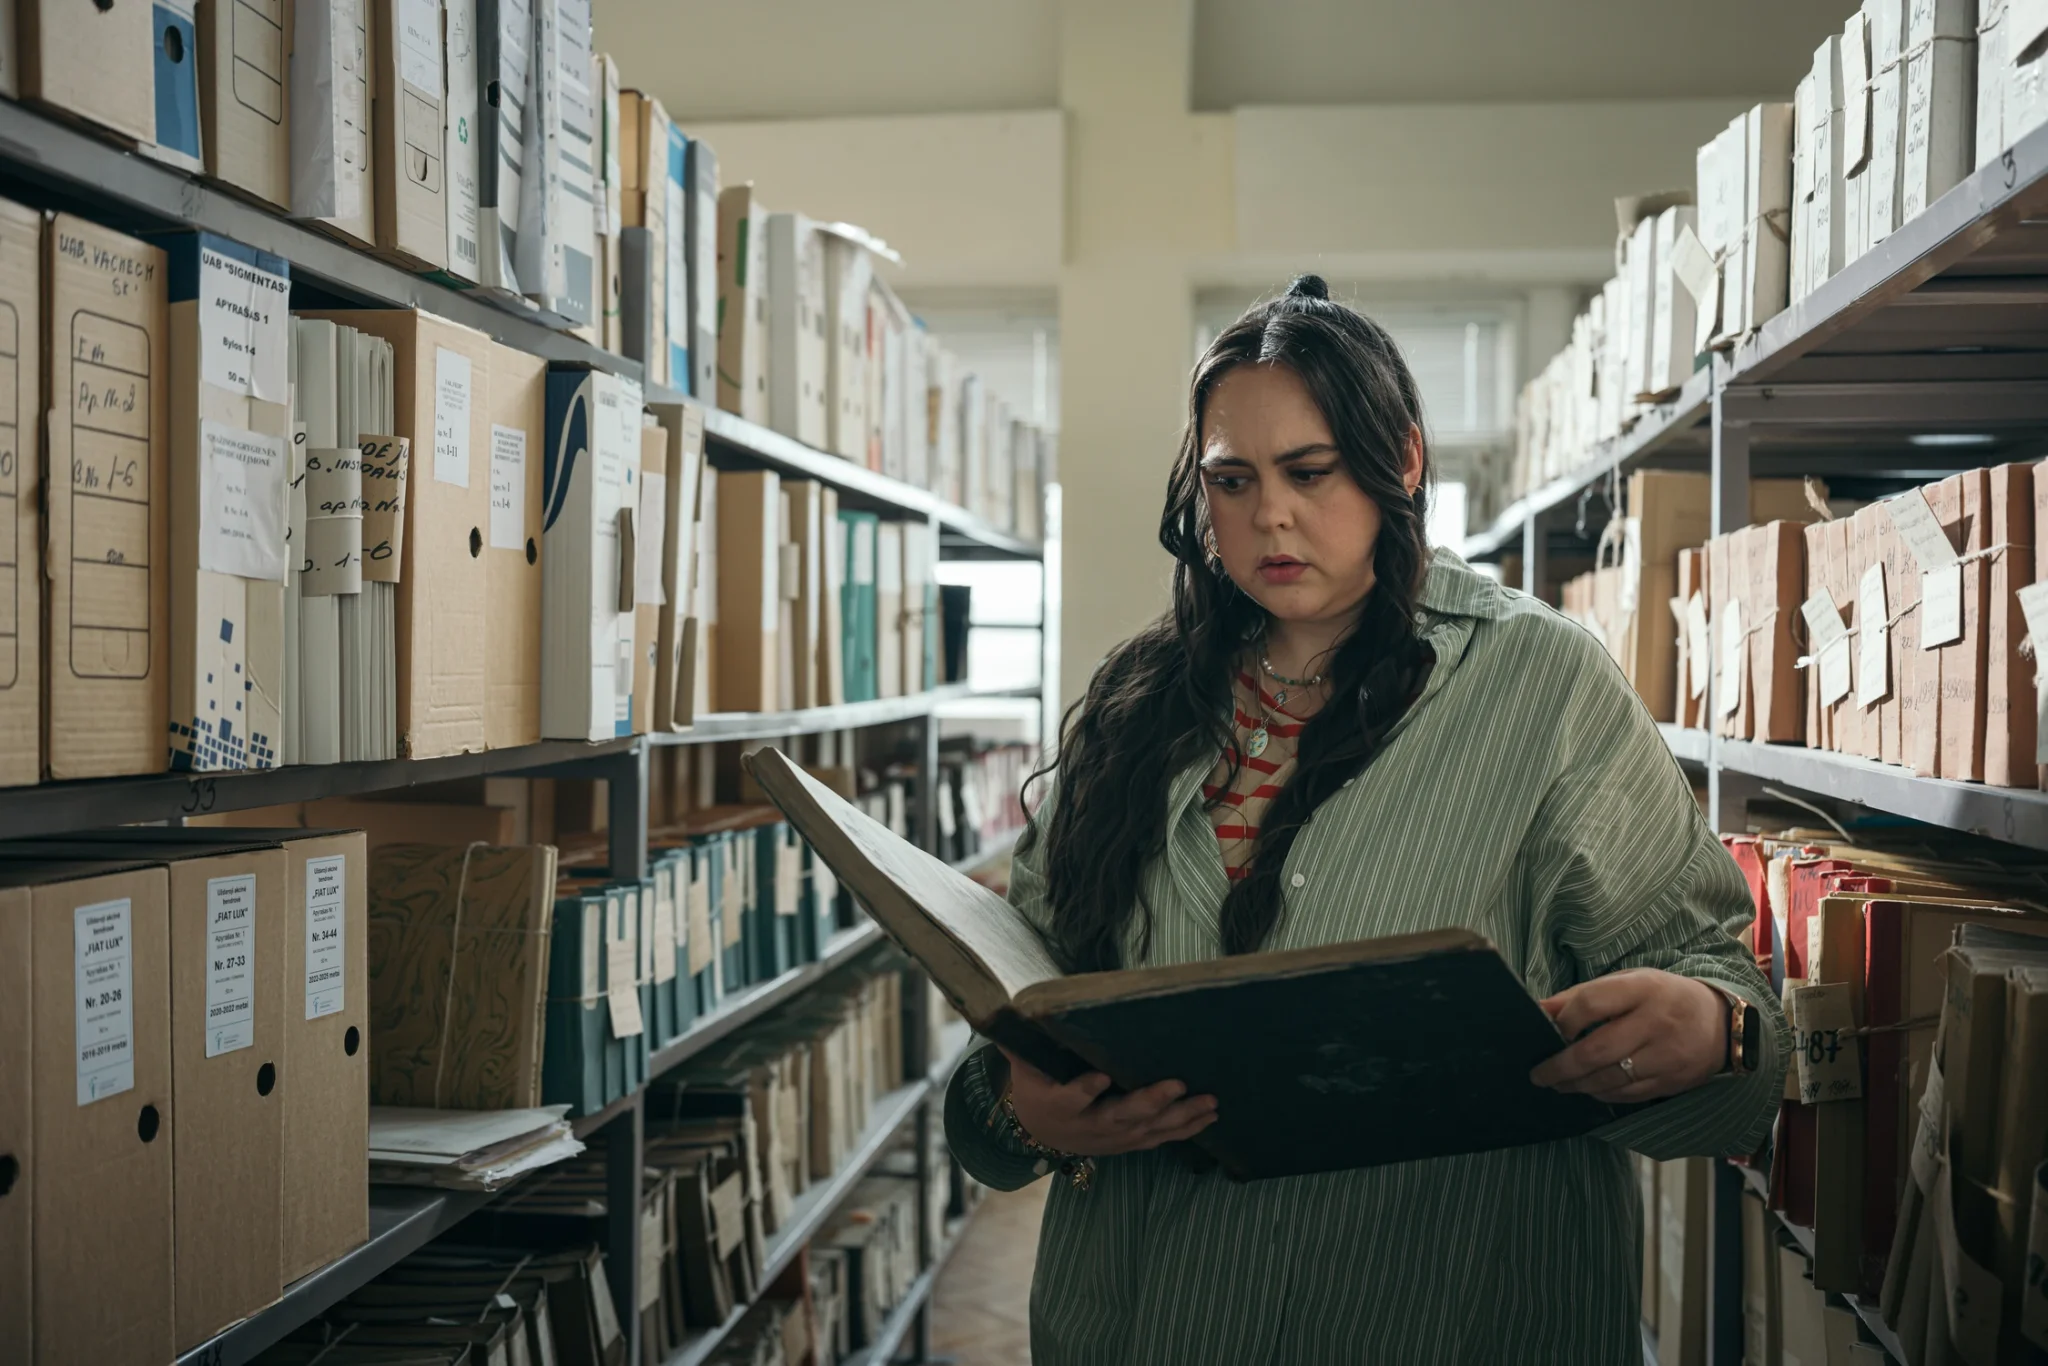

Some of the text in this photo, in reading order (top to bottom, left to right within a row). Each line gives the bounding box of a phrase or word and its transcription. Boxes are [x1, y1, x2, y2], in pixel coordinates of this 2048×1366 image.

[202, 252, 222, 270] UAB
[216, 298, 269, 325] APYRAŠAS 1
[223, 336, 256, 356] Bylos 14
[228, 372, 237, 382] 50
[312, 928, 337, 942] Nr. 34-44
[214, 955, 246, 971] Nr. 27-33
[85, 989, 122, 1010] Nr. 20-26
